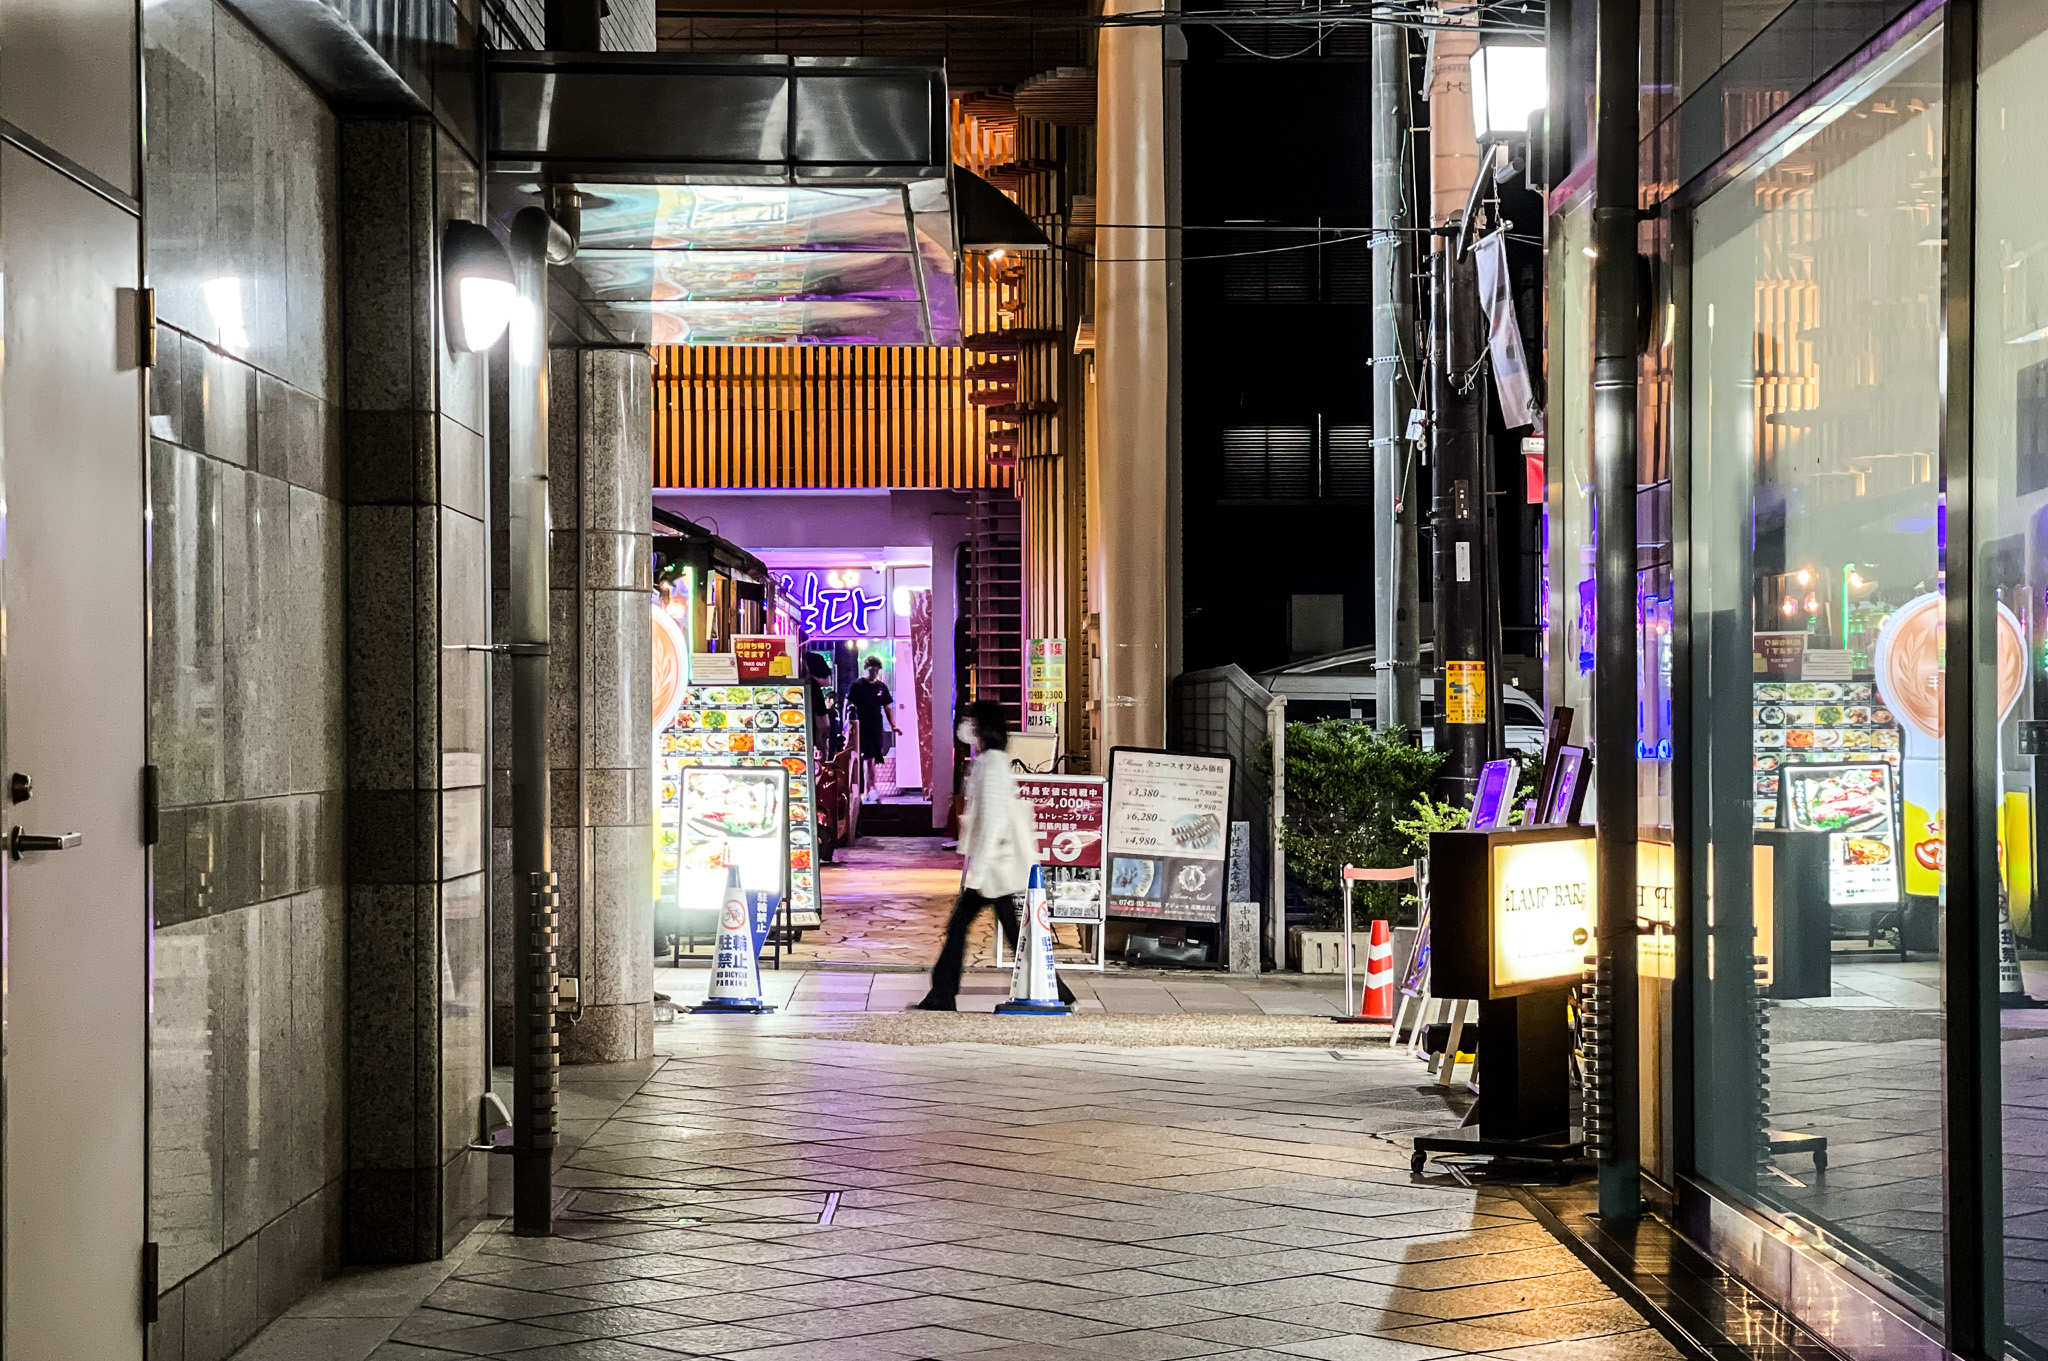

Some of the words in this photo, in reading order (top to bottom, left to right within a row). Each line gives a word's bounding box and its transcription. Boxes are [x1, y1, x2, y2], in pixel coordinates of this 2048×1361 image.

[735, 642, 772, 650] お持ち帰り
[1127, 787, 1160, 799] ¥3,380
[1126, 812, 1158, 822] ¥6,280
[1125, 836, 1157, 846] ¥4,980
[1554, 883, 1583, 907] BAR
[718, 934, 748, 952] 駐輪
[717, 952, 748, 970] 禁止
